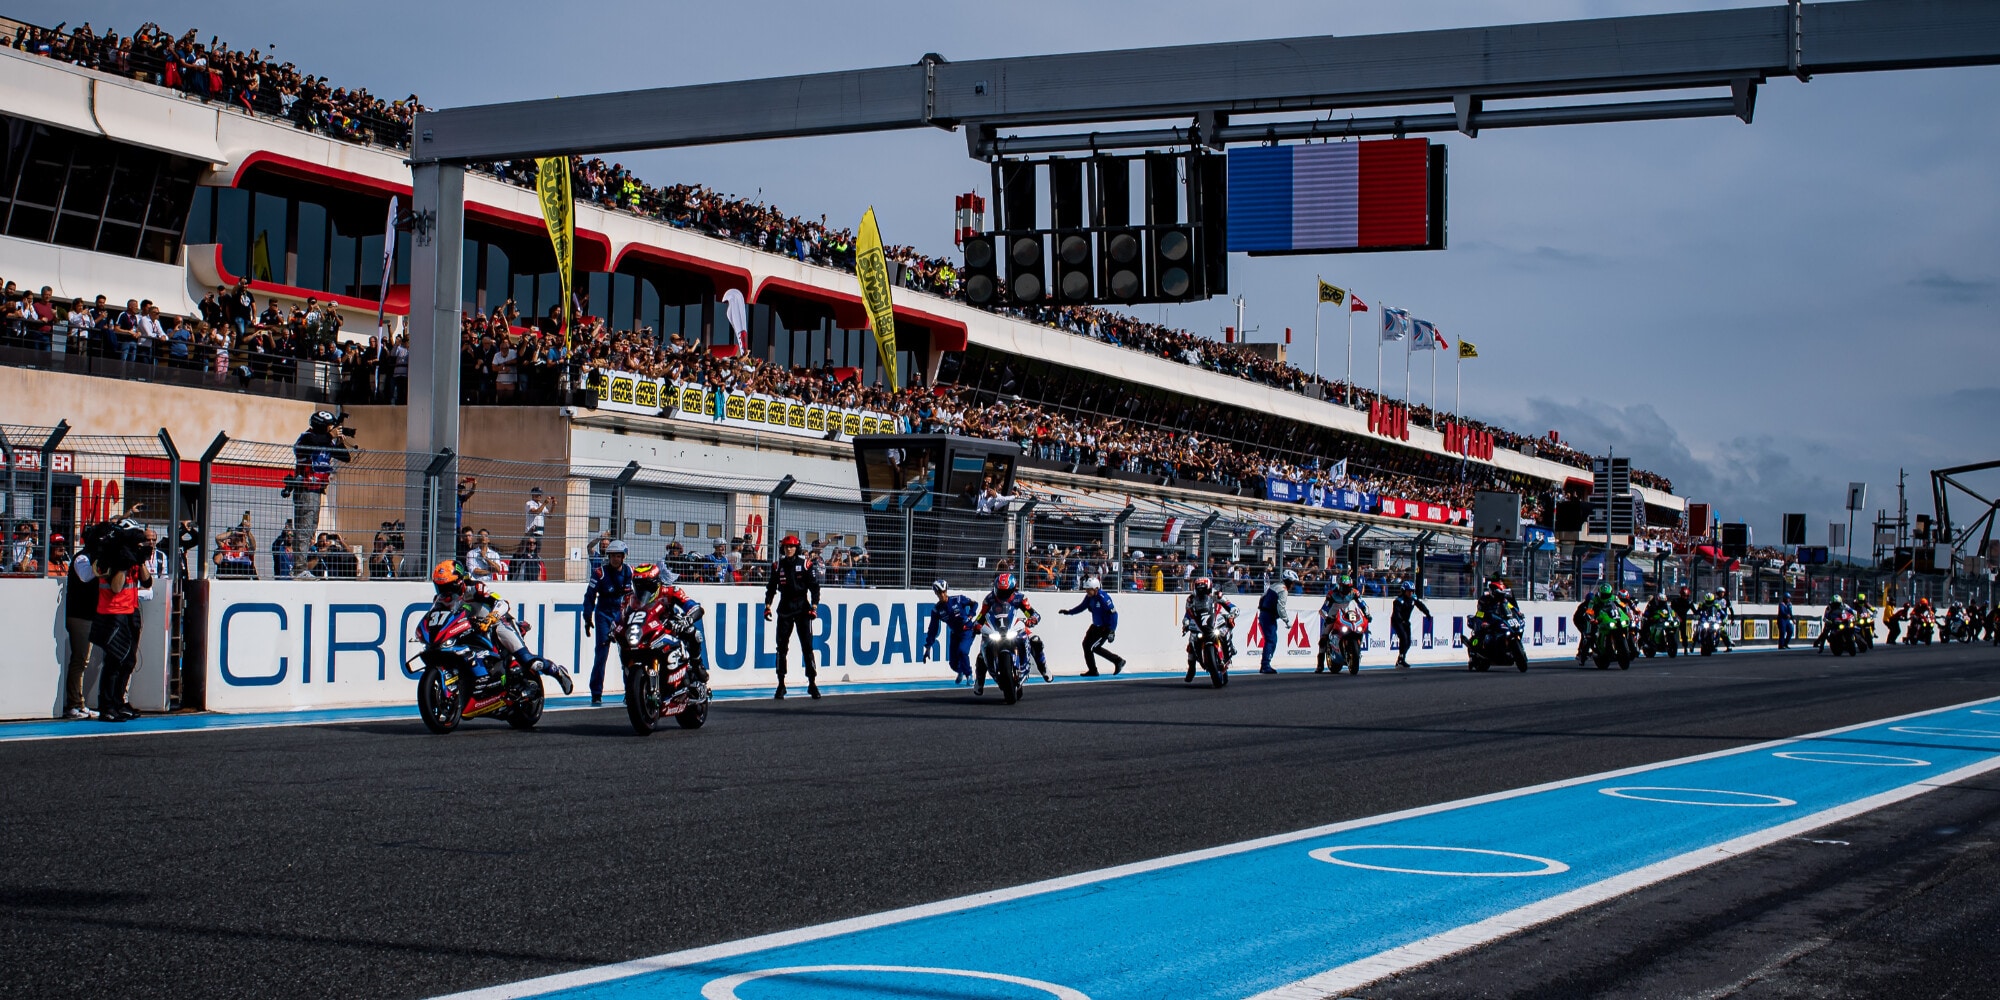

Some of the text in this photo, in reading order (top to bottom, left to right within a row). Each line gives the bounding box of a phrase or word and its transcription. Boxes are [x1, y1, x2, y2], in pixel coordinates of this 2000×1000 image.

[1368, 400, 1494, 461] PAUL RICARD
[428, 611, 451, 627] 37
[627, 611, 647, 625] 12
[998, 617, 1006, 628] 1
[1201, 614, 1211, 627] 7
[802, 602, 952, 668] RICAR
